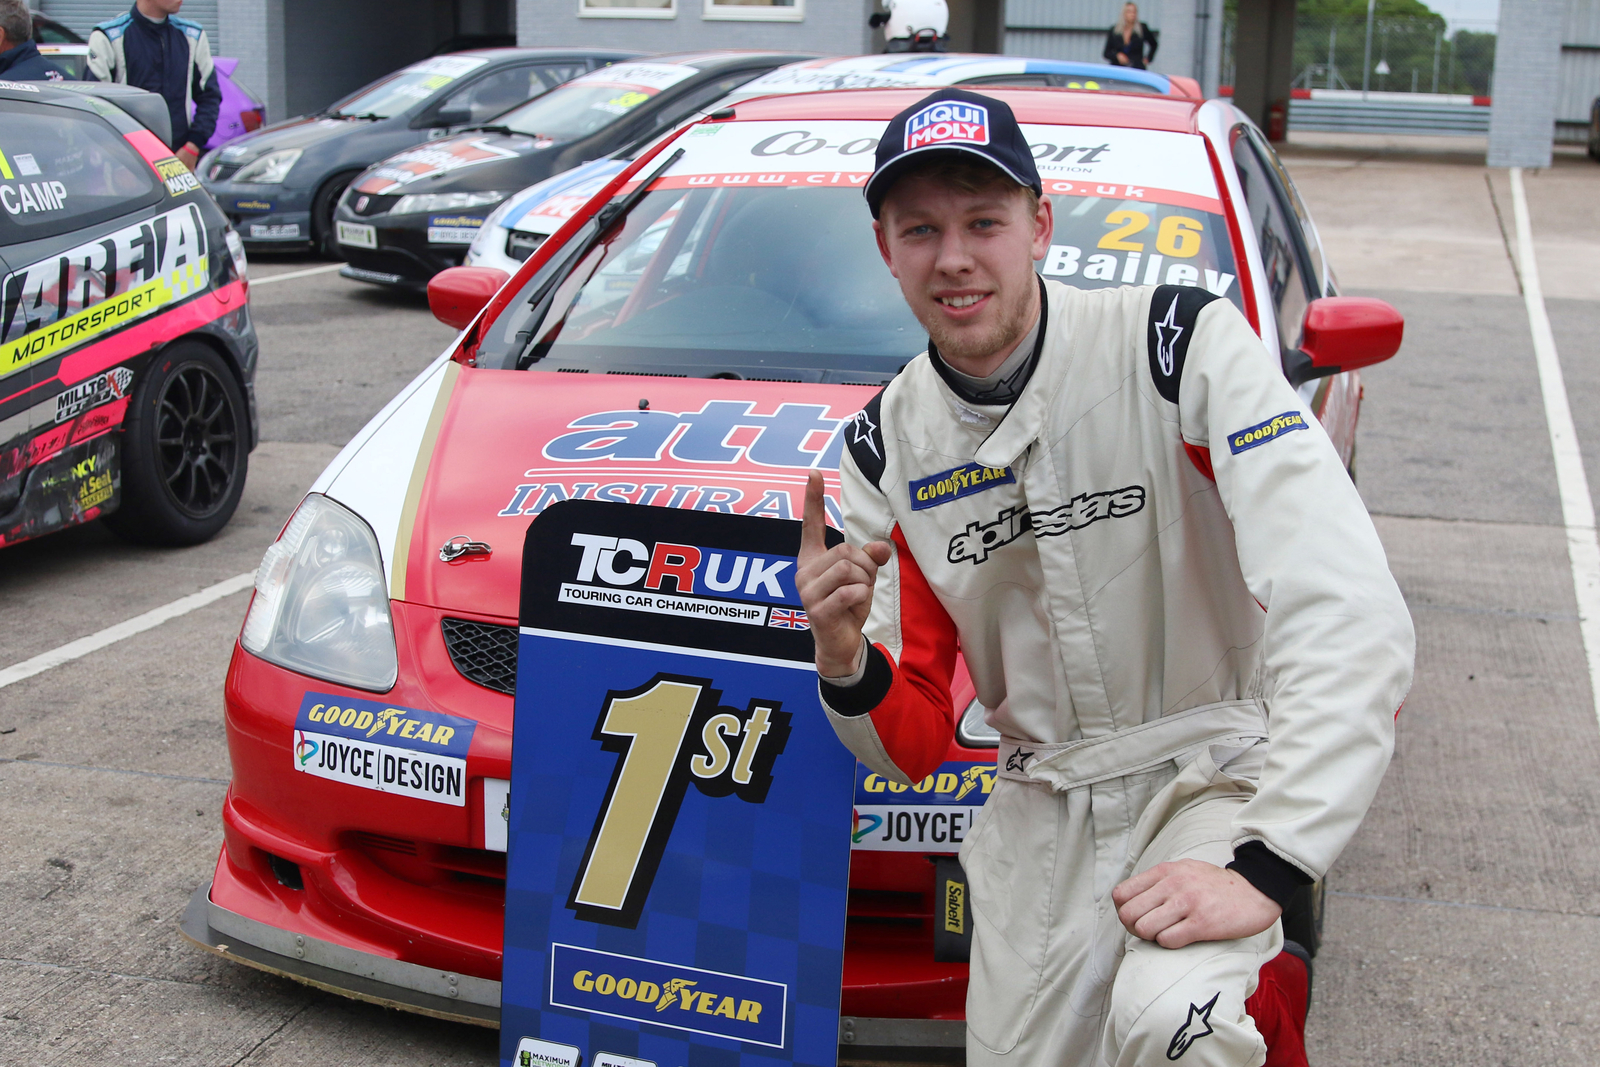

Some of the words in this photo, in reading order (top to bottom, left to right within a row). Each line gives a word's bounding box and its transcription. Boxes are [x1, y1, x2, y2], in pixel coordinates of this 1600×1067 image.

[911, 106, 980, 133] LIQUI
[911, 123, 981, 149] MOLY
[0, 180, 68, 215] CAMP
[1097, 210, 1204, 258] 26
[2, 203, 211, 345] AREA
[1042, 245, 1235, 297] Bailey
[12, 287, 156, 364] MOTORSPORT
[1234, 415, 1303, 447] GOODYEAR
[916, 467, 1007, 502] GOODYEAR
[563, 587, 623, 605] TOURING
[624, 594, 654, 608] CAR
[655, 598, 761, 621] CHAMPIONSHIP
[307, 703, 455, 746] GOODYEAR
[318, 739, 375, 780] JOYCE
[383, 754, 462, 798] DESIGN
[863, 766, 998, 802] GOODY
[881, 810, 965, 844] JOYCE
[947, 885, 962, 928] Sabelt
[572, 969, 763, 1024] GOODYEAR
[532, 1052, 571, 1066] MAXIMUM
